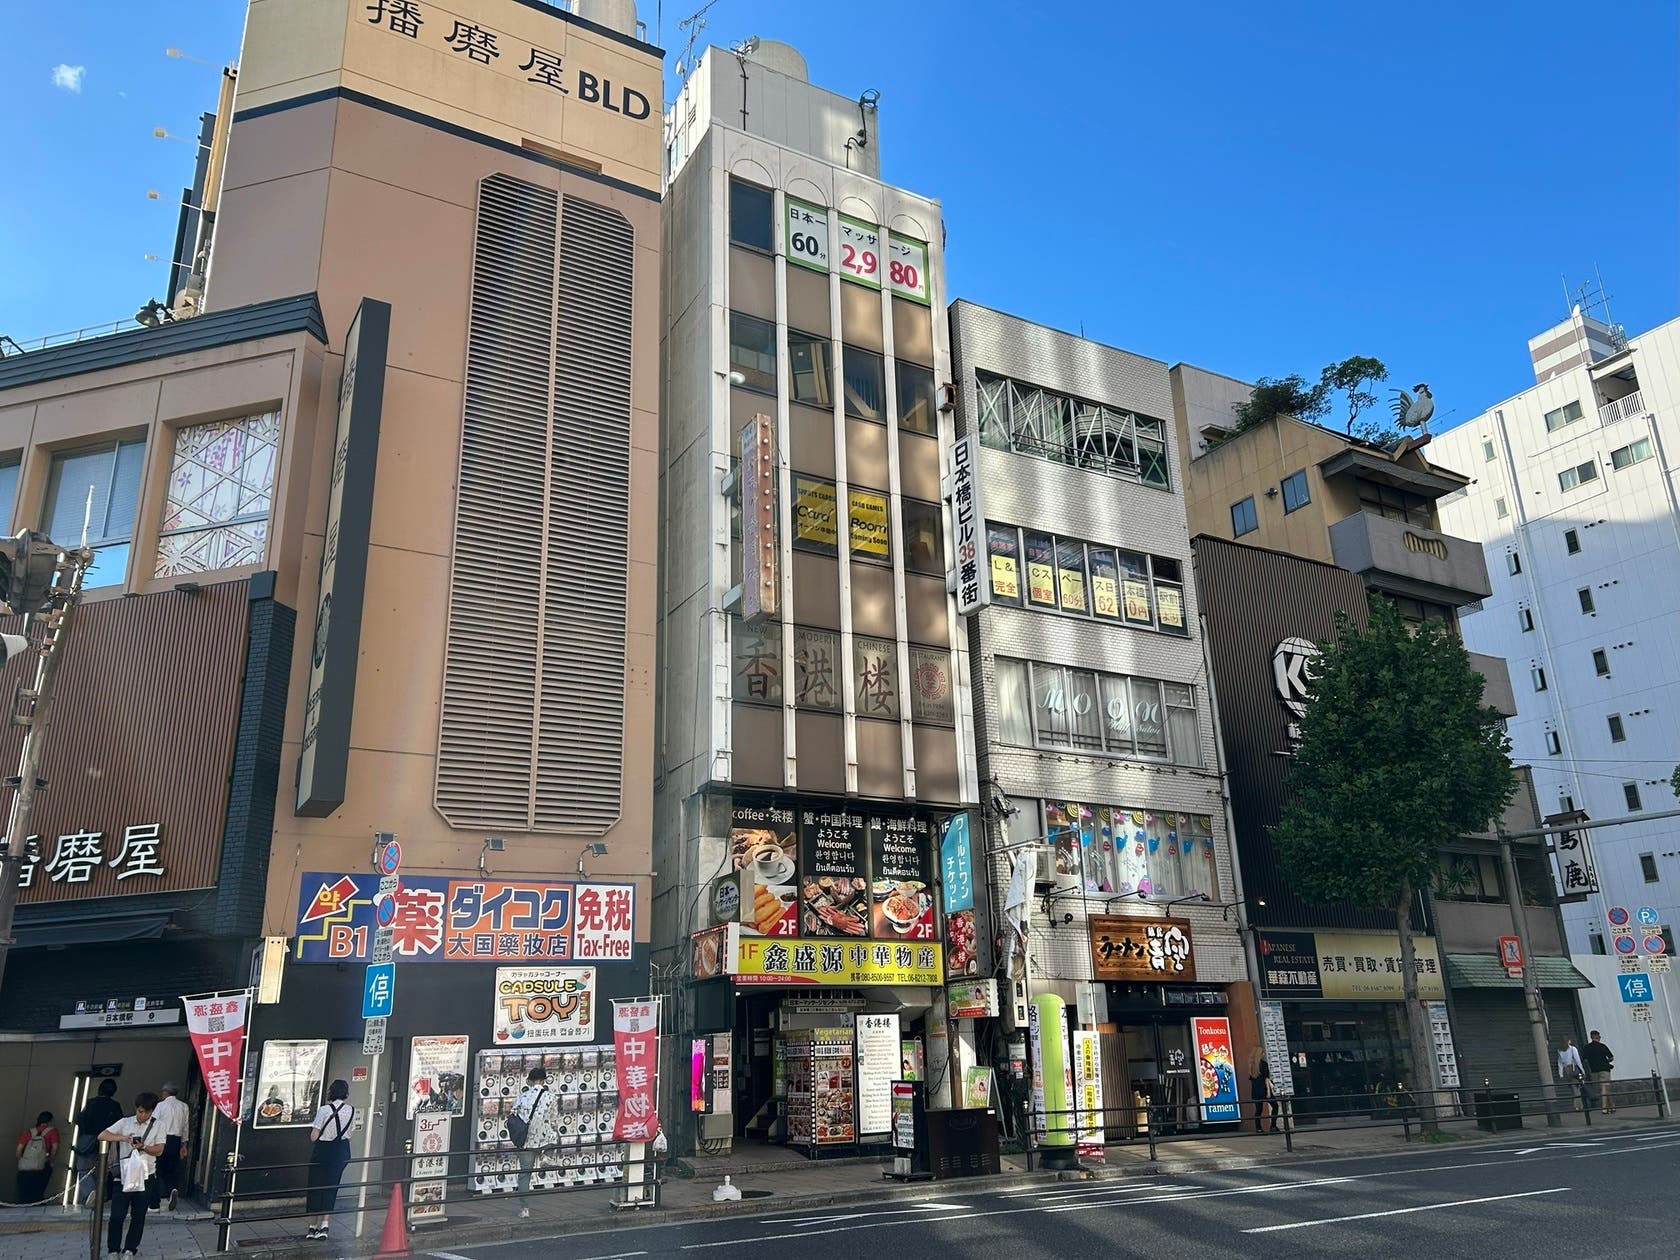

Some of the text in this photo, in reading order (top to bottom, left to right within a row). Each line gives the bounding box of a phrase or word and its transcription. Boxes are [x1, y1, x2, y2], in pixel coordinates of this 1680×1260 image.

[366, 0, 651, 120] 播磨屋 BLD
[790, 208, 826, 226] 日本一
[797, 504, 834, 523] Card
[850, 517, 887, 534] Room
[954, 442, 978, 607] 日本橋ビル38番街
[747, 624, 768, 635] NEW
[799, 632, 836, 645] MODERN
[857, 640, 891, 653] CHINESE
[817, 828, 849, 839] ようこそ
[941, 821, 950, 834] 1F
[816, 839, 852, 850] Welcome
[883, 833, 914, 844] ようこそ
[815, 850, 855, 861] 환영합니다
[883, 843, 917, 854] Welcome
[882, 853, 920, 866] 환영합니다
[955, 816, 969, 899] ワールドワン
[947, 856, 957, 910] チケット
[319, 888, 340, 911] 약
[450, 885, 572, 932] ダイコク
[577, 886, 632, 932] 免税
[778, 919, 797, 935] 2F
[916, 922, 933, 938] 2F
[1611, 926, 1632, 934] ここまで
[329, 925, 369, 959] B1
[577, 936, 630, 959] Tax-Free
[1263, 940, 1297, 953] JAPANESE
[738, 943, 759, 960] 1F
[1273, 955, 1316, 964] REAL ESTATE
[369, 973, 389, 1008] 停
[499, 979, 578, 995] CAPSULE
[1625, 978, 1648, 998] 停
[500, 993, 580, 1024] TOY
[1197, 1026, 1227, 1035] Tonkotsu
[1208, 1104, 1235, 1113] ramen
